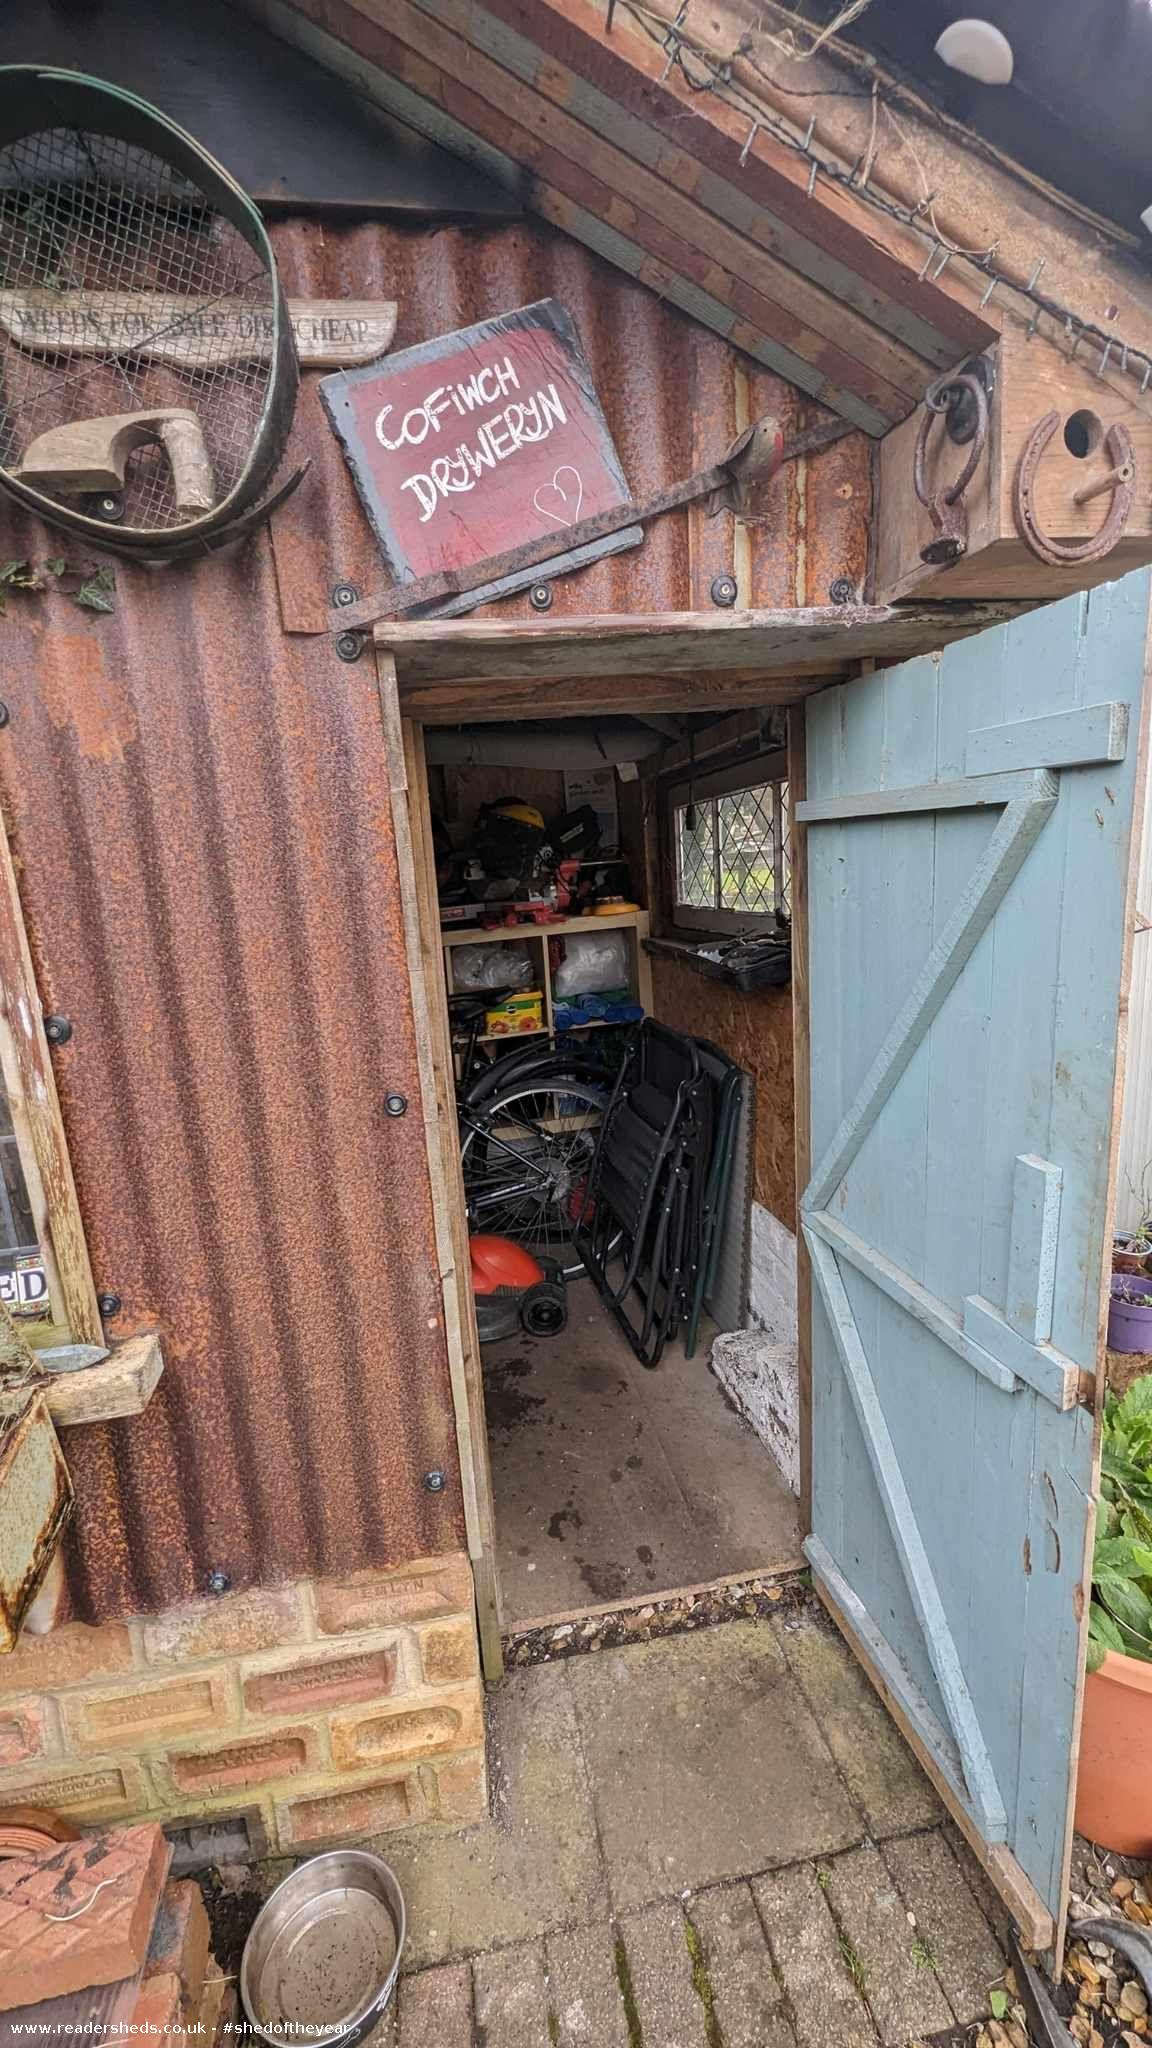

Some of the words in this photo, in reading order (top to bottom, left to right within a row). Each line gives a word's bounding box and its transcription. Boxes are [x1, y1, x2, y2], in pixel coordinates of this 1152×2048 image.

[14, 308, 100, 334] WEEDS
[110, 311, 154, 336] FOR
[400, 383, 568, 522] DRYWERYN
